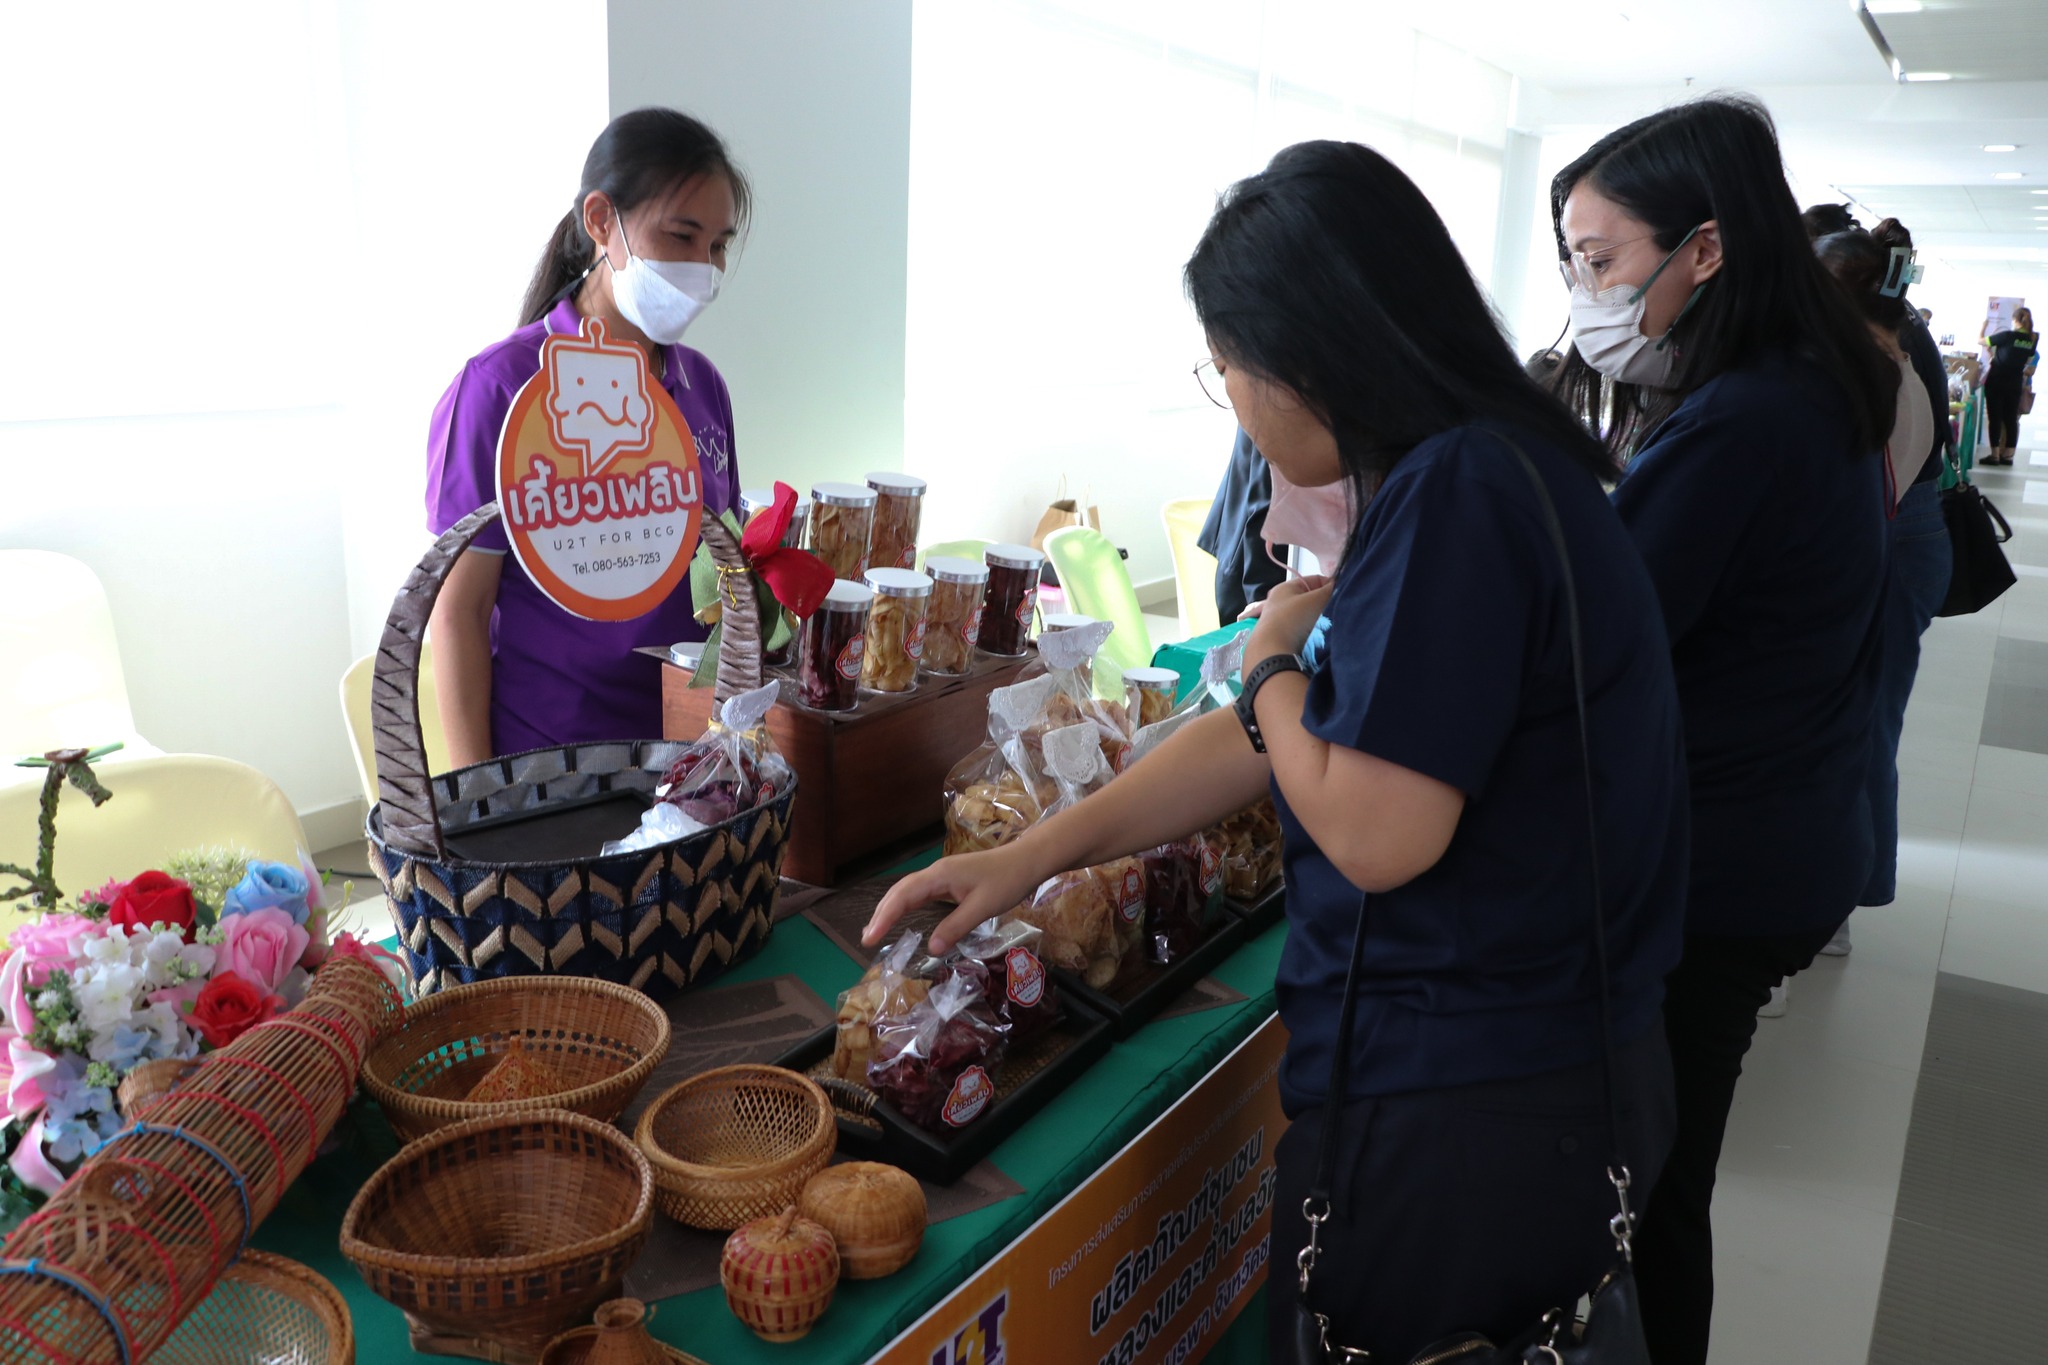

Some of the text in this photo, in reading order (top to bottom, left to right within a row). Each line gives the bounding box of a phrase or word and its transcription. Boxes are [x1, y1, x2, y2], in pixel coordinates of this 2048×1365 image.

[509, 461, 698, 526] เคี้ยวเพลิน
[553, 527, 675, 551] U2T FOR BCG
[572, 552, 661, 576] Tel. 080-563-7253
[1090, 1126, 1265, 1336] ผลิตภัณฑ์ชุมชน
[1213, 1232, 1271, 1321] จังหวัดช
